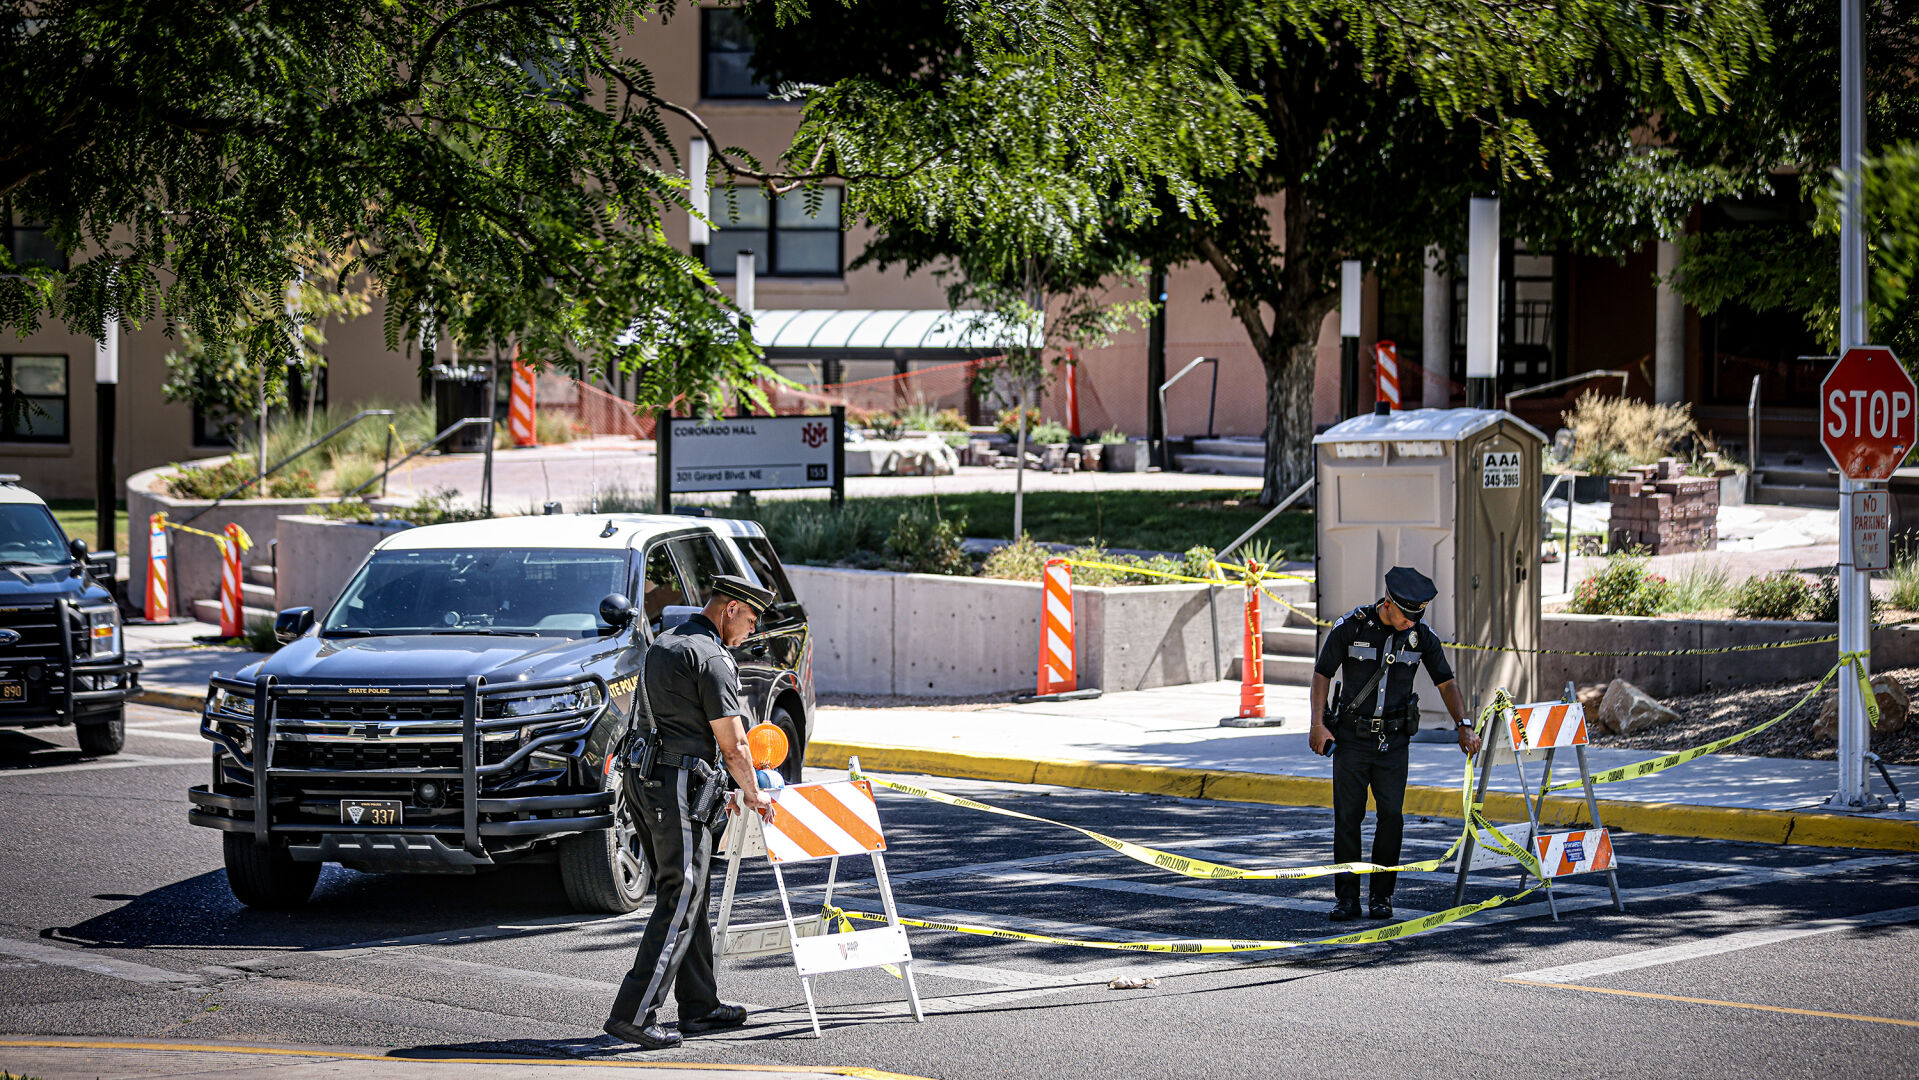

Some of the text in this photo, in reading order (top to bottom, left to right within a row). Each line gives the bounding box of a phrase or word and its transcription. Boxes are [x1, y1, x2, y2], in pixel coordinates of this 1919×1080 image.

[1828, 389, 1911, 438] STOP
[674, 425, 757, 437] CORONADO HALL
[677, 472, 692, 482] 301
[694, 471, 722, 482] Girard
[749, 470, 762, 480] NE
[1484, 474, 1519, 487] 345-3965
[1863, 497, 1877, 513] NO
[1855, 515, 1886, 530] PARKING
[1863, 532, 1877, 543] ANY
[1861, 544, 1879, 554] TIME
[4, 686, 21, 697] 890
[371, 809, 395, 825] 337
